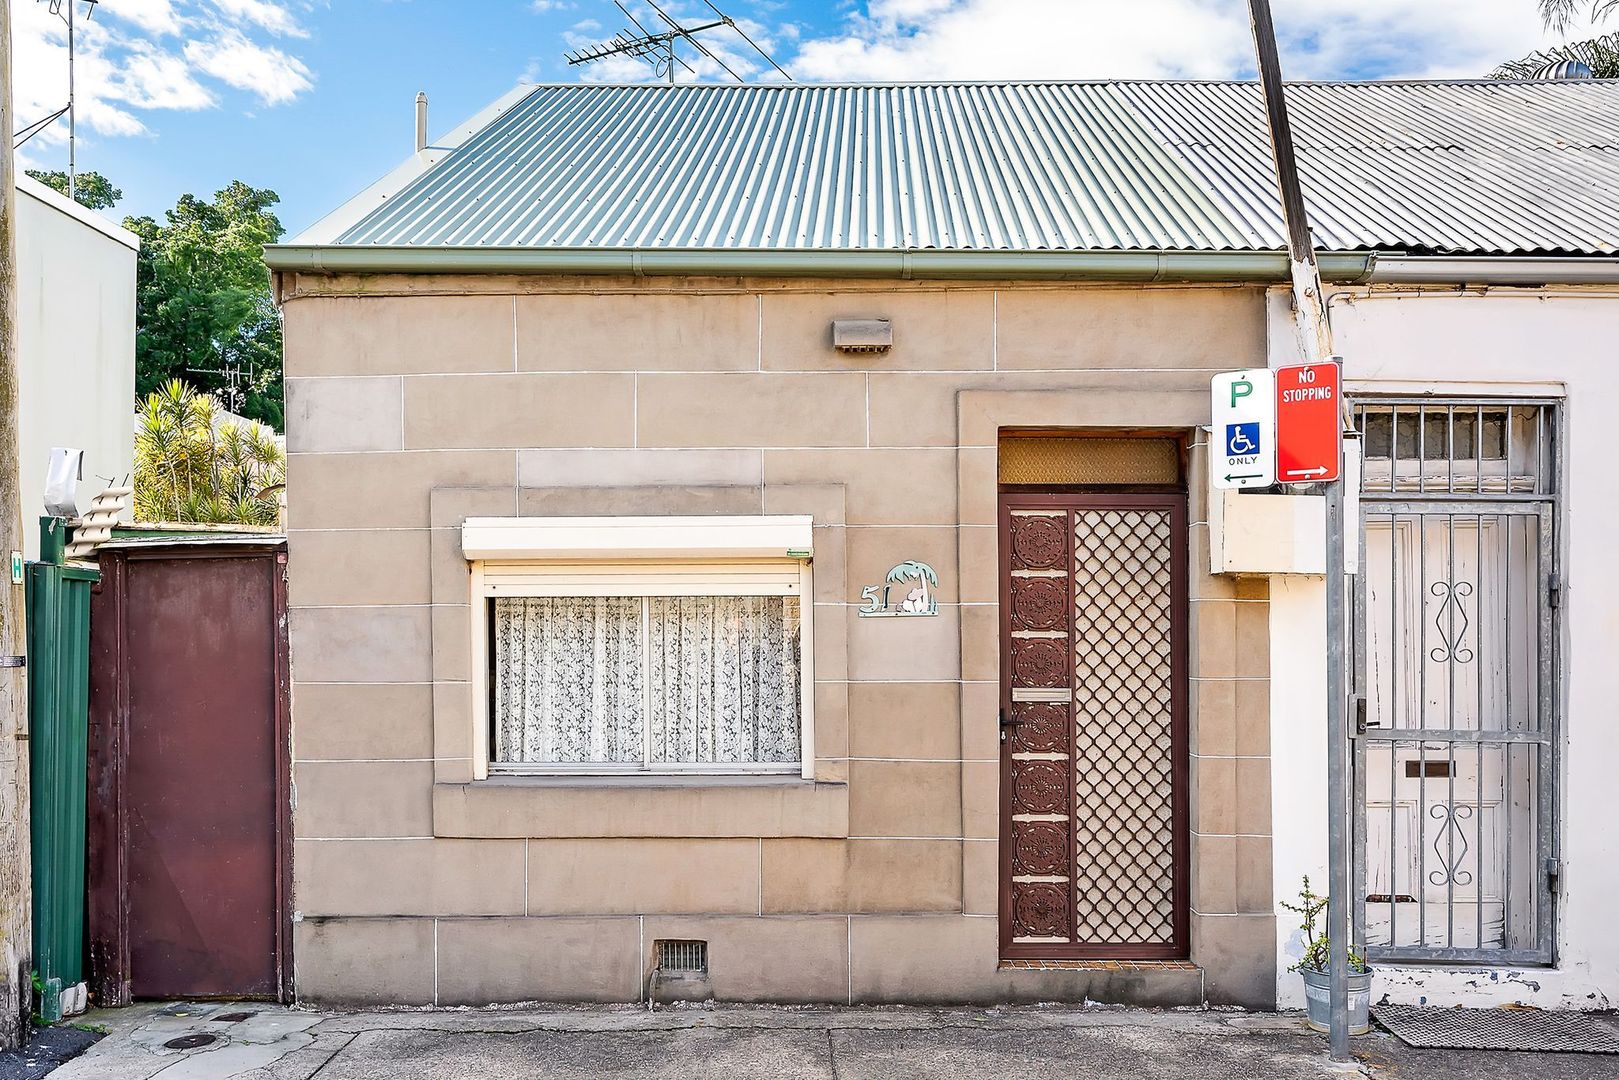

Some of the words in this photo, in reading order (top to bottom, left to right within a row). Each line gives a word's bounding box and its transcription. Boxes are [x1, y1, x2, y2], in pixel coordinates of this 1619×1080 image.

[1298, 370, 1316, 384] NO
[1231, 381, 1253, 408] P
[1283, 386, 1332, 403] STOPPING
[1228, 456, 1258, 466] ONLY
[13, 558, 22, 579] H
[859, 585, 891, 613] 51
